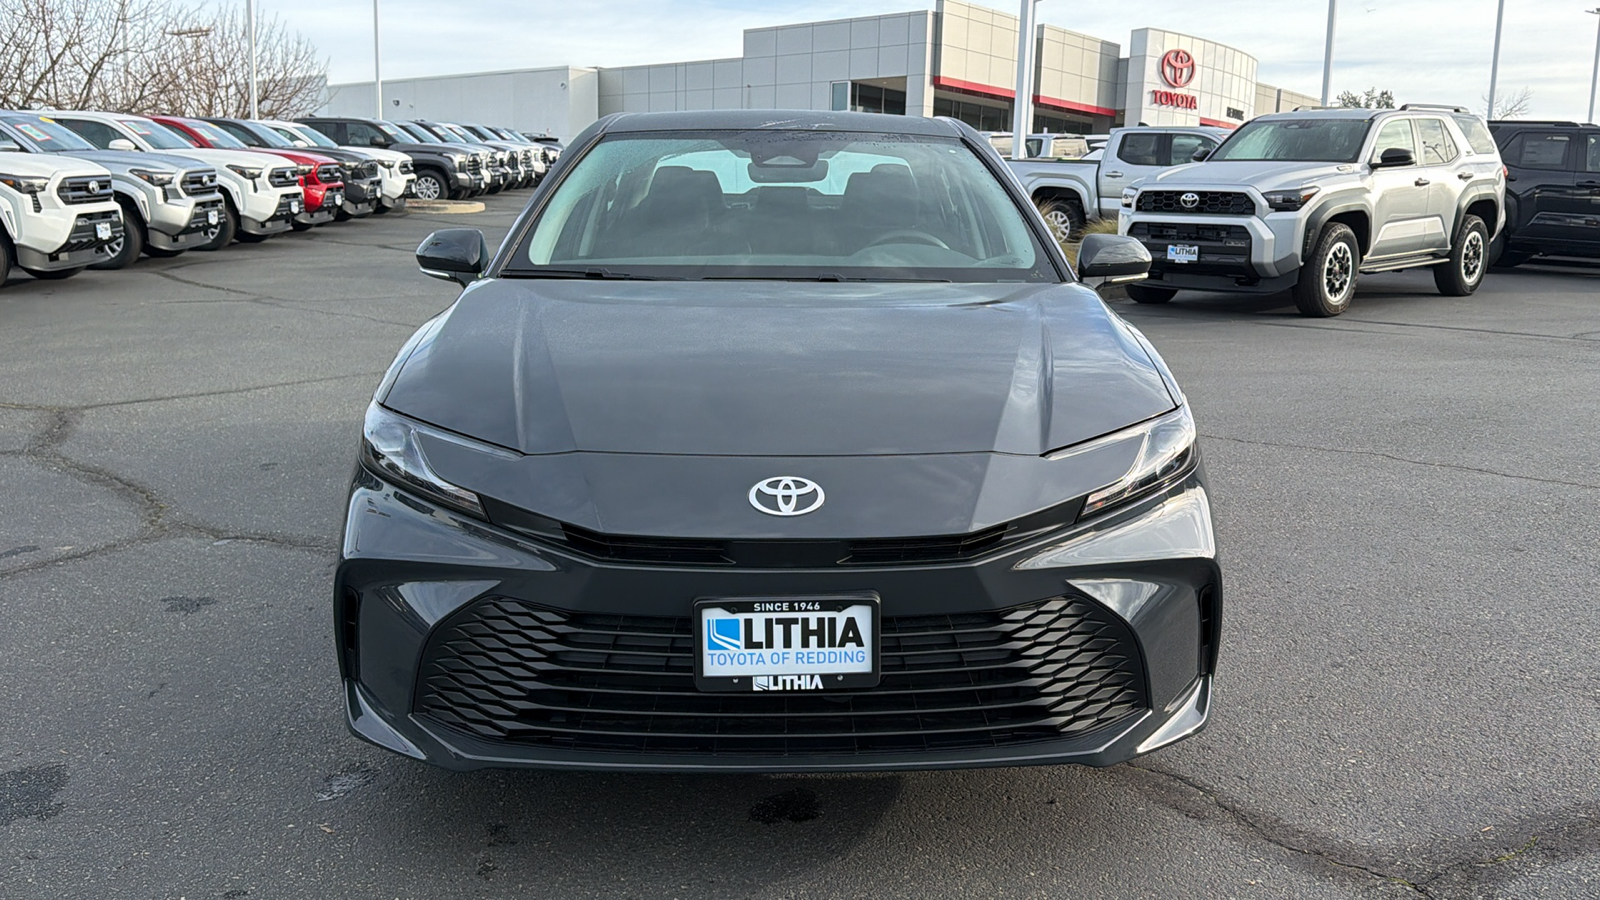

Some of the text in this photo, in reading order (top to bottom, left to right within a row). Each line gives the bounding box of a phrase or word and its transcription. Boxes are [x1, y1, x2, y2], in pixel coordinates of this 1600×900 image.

[1152, 90, 1197, 109] TOYOTA
[754, 602, 820, 612] SINCE 1946
[744, 617, 865, 649] LITHIA
[708, 650, 866, 666] TOYOTA OF REDDING
[768, 675, 823, 690] LITHIA
